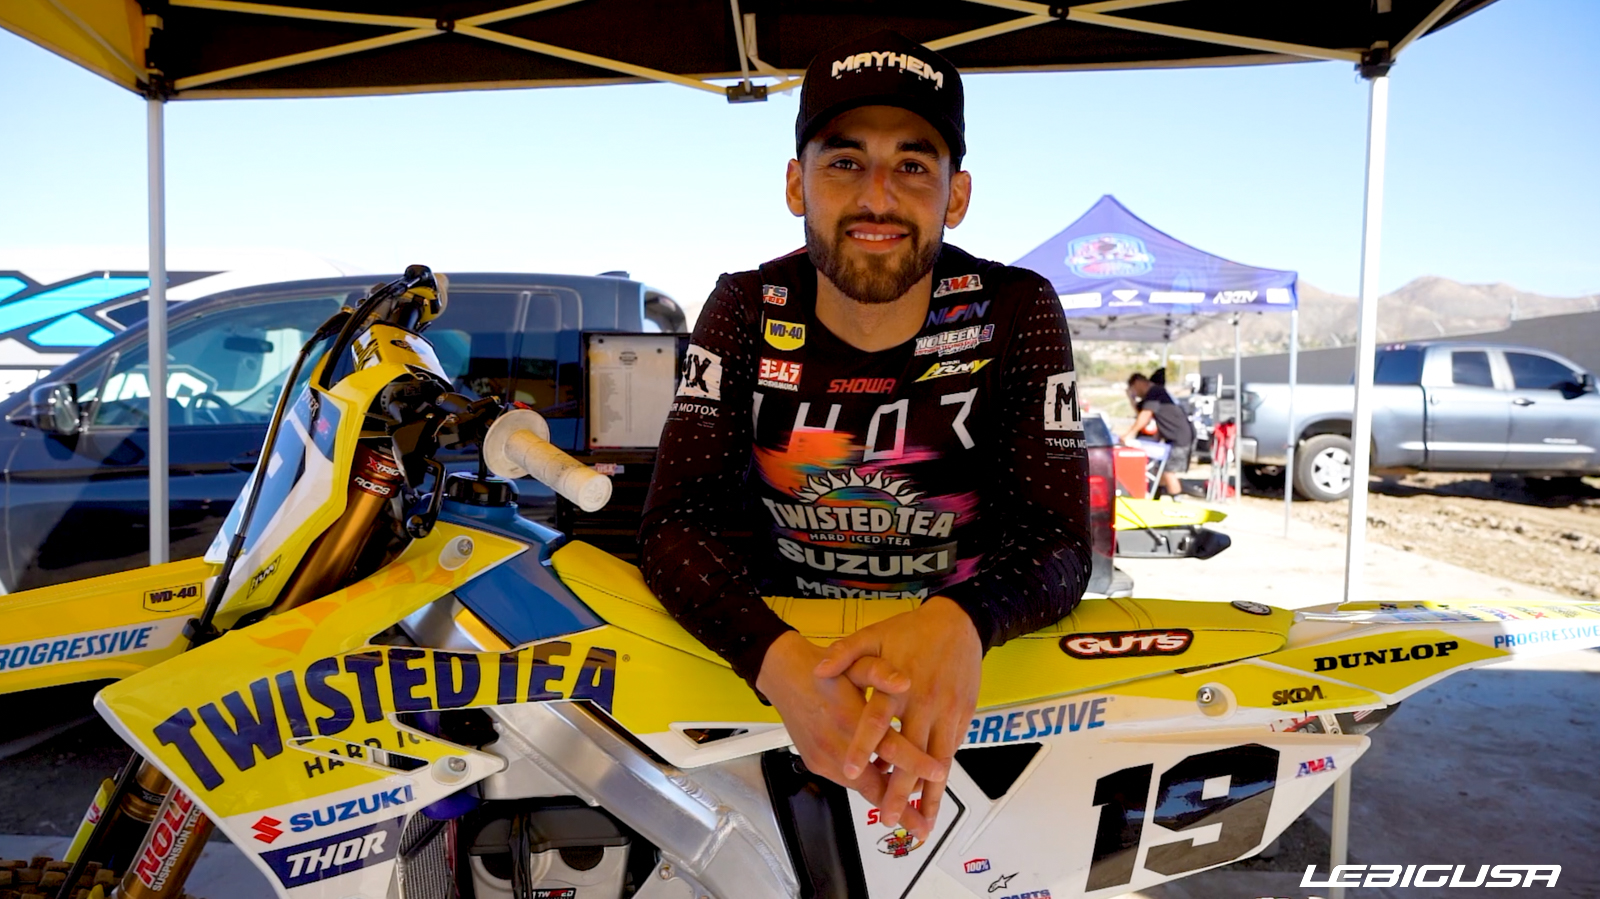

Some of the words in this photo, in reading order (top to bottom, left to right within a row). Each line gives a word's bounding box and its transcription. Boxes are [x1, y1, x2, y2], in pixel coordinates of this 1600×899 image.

[831, 51, 944, 89] MAYHEM
[934, 274, 983, 297] AMA
[770, 322, 803, 340] WD-40
[916, 326, 981, 351] NOLEEN
[911, 358, 995, 384] ARMY
[827, 378, 896, 394] SHOWA
[1045, 437, 1077, 448] THOR
[354, 476, 391, 495] ROCS
[762, 497, 892, 533] TWISTED
[894, 508, 956, 538] TEA
[809, 533, 845, 543] HARD
[851, 535, 881, 545] ICED
[887, 536, 911, 547] TEA
[777, 538, 950, 577] SUZUKI
[150, 586, 196, 604] WD-40
[796, 576, 929, 600] MAYHEM
[1066, 634, 1188, 655] GUTS
[1494, 625, 1600, 649] PROGRESSIVE
[1314, 640, 1459, 673] DUNLOP
[1272, 685, 1324, 706] SKDA
[152, 646, 481, 792] TWISTED
[497, 641, 617, 717] TEA
[1296, 756, 1337, 779] AMA
[289, 784, 414, 833] SUZUKI
[1085, 742, 1281, 893] 19
[152, 829, 192, 892] SUSPENSION
[286, 830, 388, 879] THOR
[966, 860, 989, 872] 100%
